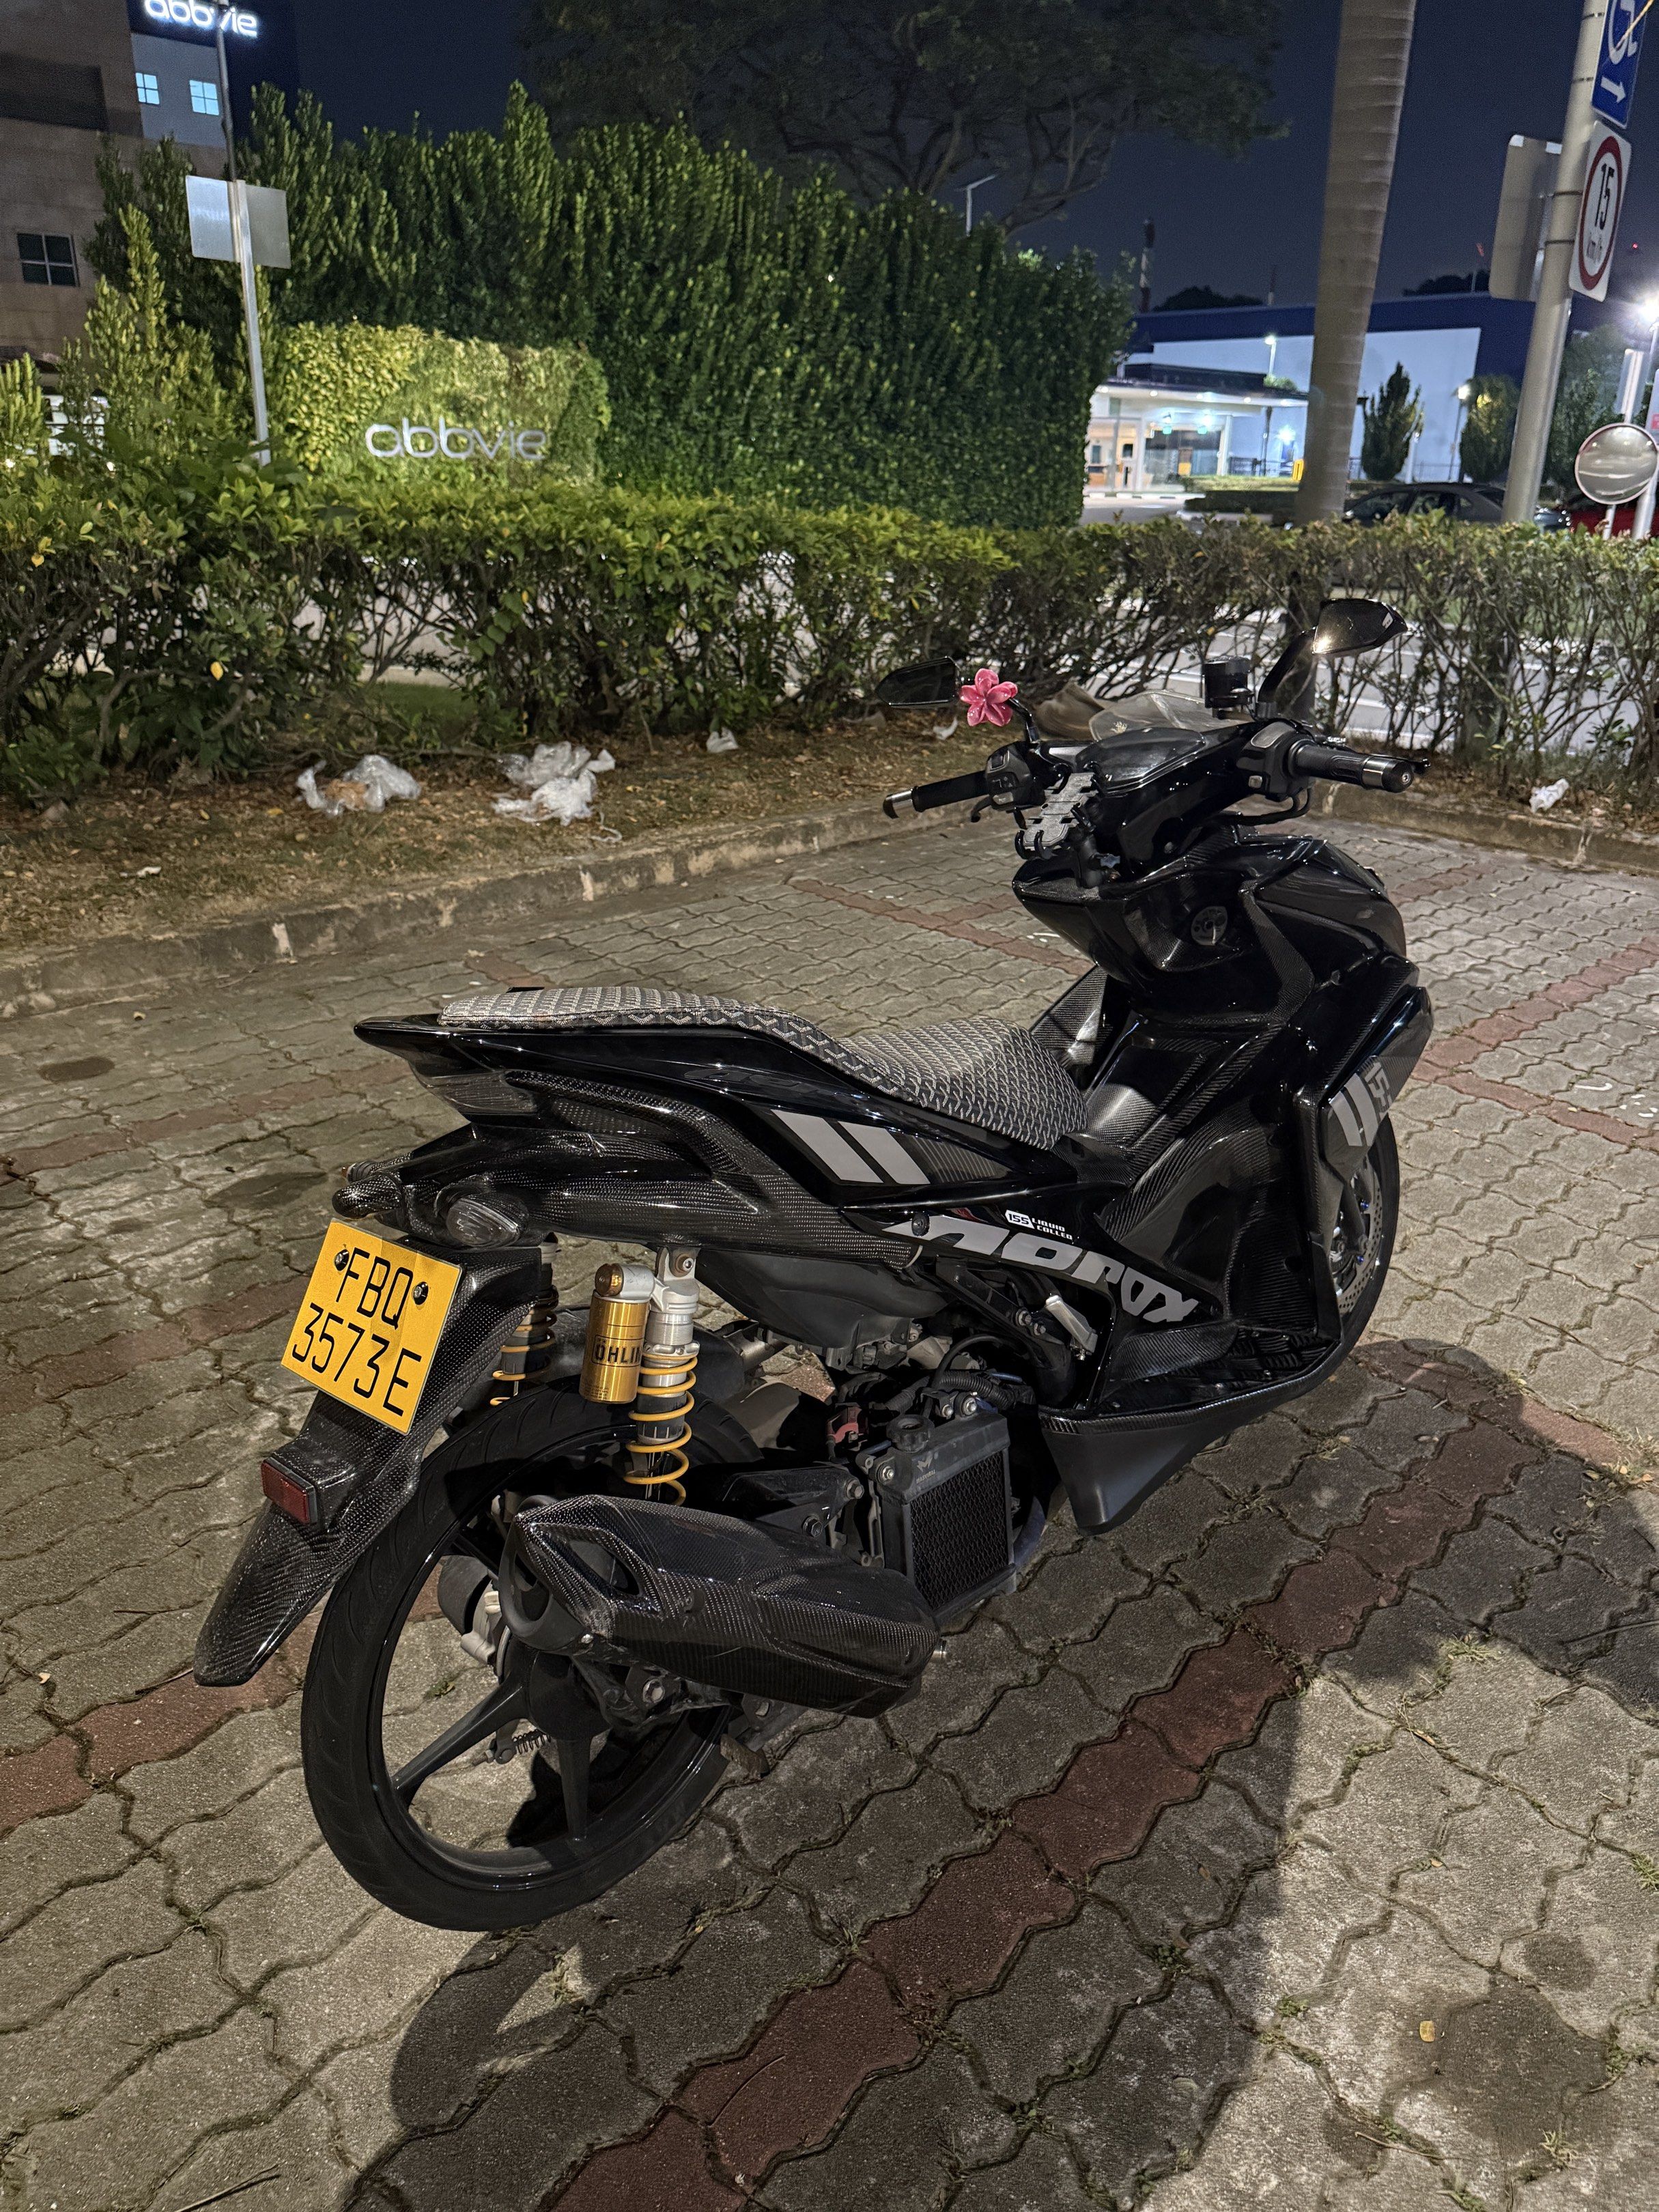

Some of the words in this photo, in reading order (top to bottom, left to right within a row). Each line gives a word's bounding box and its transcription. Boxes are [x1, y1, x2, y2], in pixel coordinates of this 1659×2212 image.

[1595, 163, 1615, 230] 15
[365, 416, 546, 460] abbvie
[1008, 1214, 1030, 1225] 155
[1032, 1217, 1066, 1232] LIQUID
[336, 1247, 414, 1330] FBQ
[292, 1302, 423, 1417] 3573E
